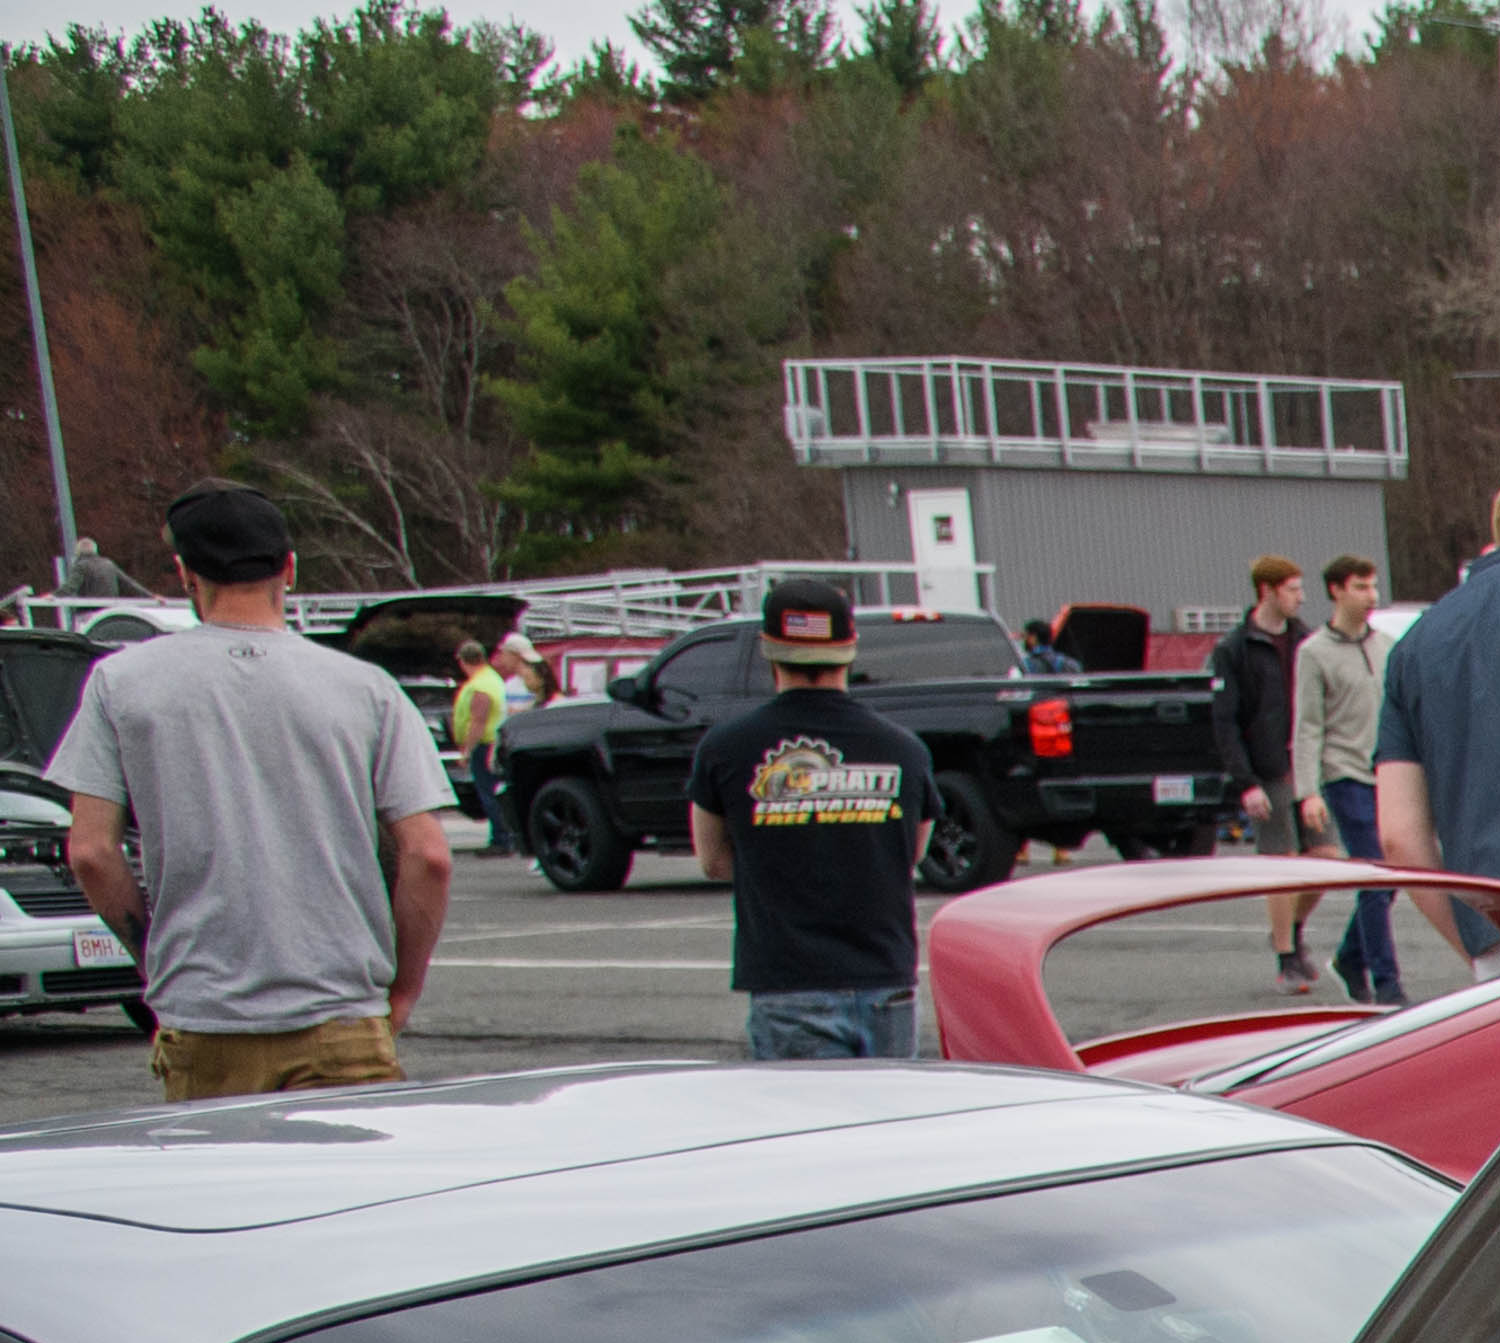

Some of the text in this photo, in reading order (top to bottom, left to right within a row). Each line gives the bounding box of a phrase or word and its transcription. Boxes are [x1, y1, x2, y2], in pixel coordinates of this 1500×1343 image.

[809, 769, 895, 792] PRATT
[754, 799, 892, 814] EXCAVATION
[752, 810, 888, 826] TREE WORK
